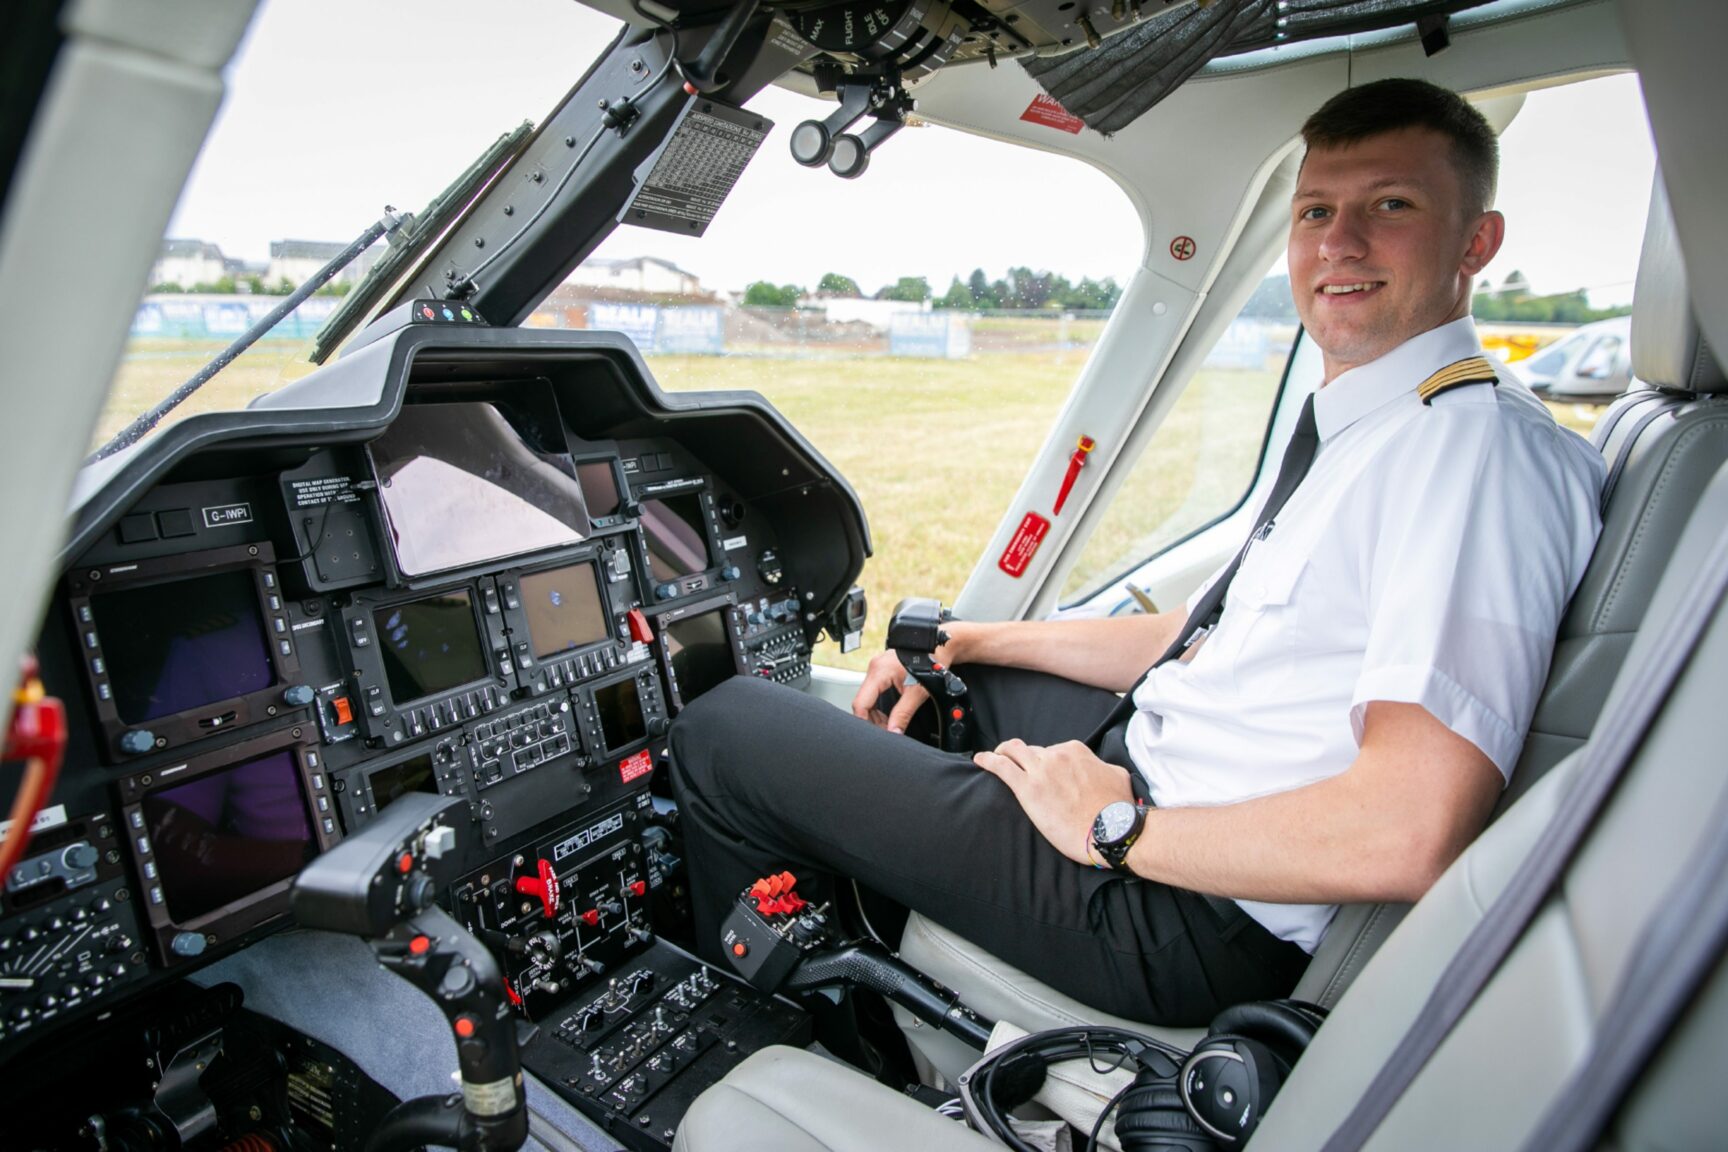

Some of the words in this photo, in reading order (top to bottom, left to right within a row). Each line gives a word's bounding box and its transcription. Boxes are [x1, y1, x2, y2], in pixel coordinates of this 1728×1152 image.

[864, 13, 878, 36] IDLE
[875, 8, 890, 26] OFF
[809, 18, 824, 41] MAX
[845, 11, 853, 45] FLIGHT
[297, 492, 324, 500] OPERATION
[297, 498, 320, 506] CONTACT
[211, 507, 248, 522] G-IWPI
[546, 878, 554, 904] BRAKE
[498, 901, 505, 909] UP
[501, 916, 516, 929] DOWN
[528, 936, 541, 946] PULL
